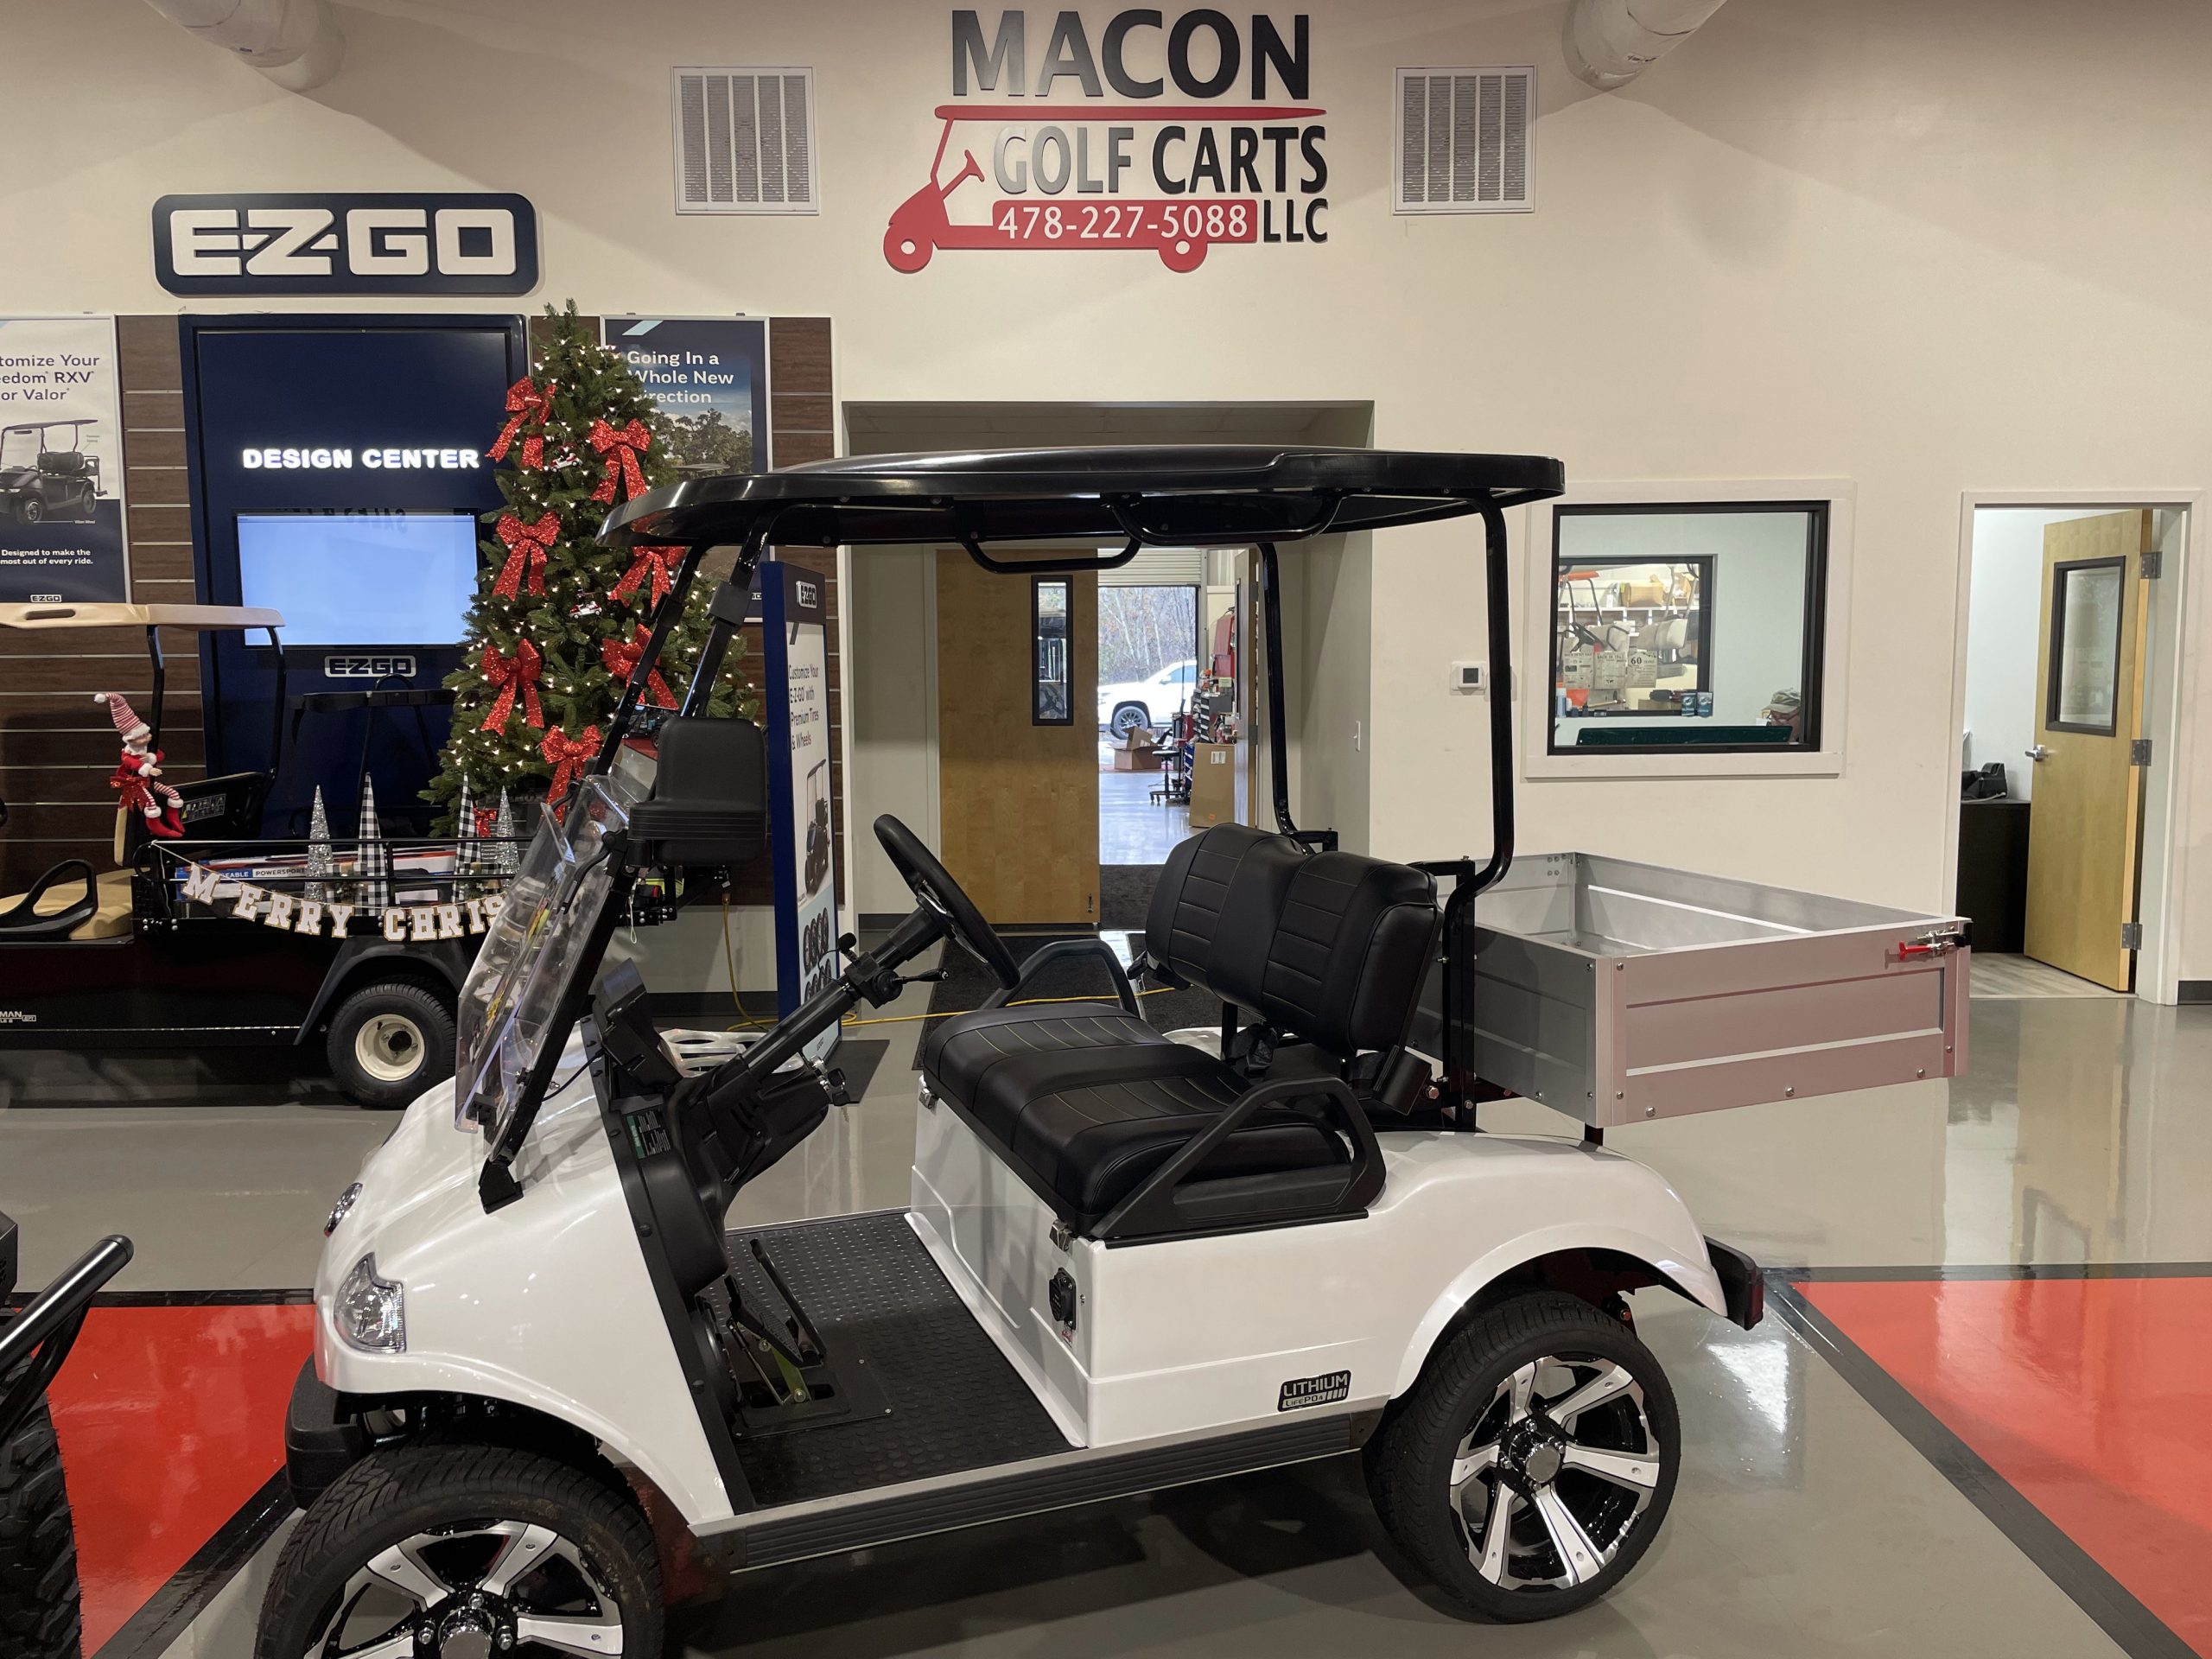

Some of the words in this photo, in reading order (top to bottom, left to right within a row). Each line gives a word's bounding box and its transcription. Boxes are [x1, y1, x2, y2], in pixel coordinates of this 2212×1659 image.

[951, 8, 1310, 101] MACON
[993, 125, 1135, 194] GOLF
[1152, 125, 1328, 194] CARTS
[997, 204, 1249, 240] 478-227-5088
[1262, 198, 1329, 244] LLC
[60, 354, 100, 366] Your
[626, 350, 680, 367] Going
[686, 351, 703, 365] In
[709, 354, 720, 365] a
[627, 370, 688, 384] Whole
[693, 370, 734, 385] New
[1, 391, 17, 400] or
[22, 389, 67, 400] Valor
[638, 390, 712, 404] irection
[243, 448, 353, 468] DESIGN
[361, 448, 480, 468] CENTER
[1, 549, 40, 557] Designed
[791, 710, 810, 727] Premium
[810, 708, 819, 722] Tires
[796, 730, 811, 749] Wheels
[182, 862, 354, 939] MERRY
[1283, 1373, 1348, 1397] LITHIUM
